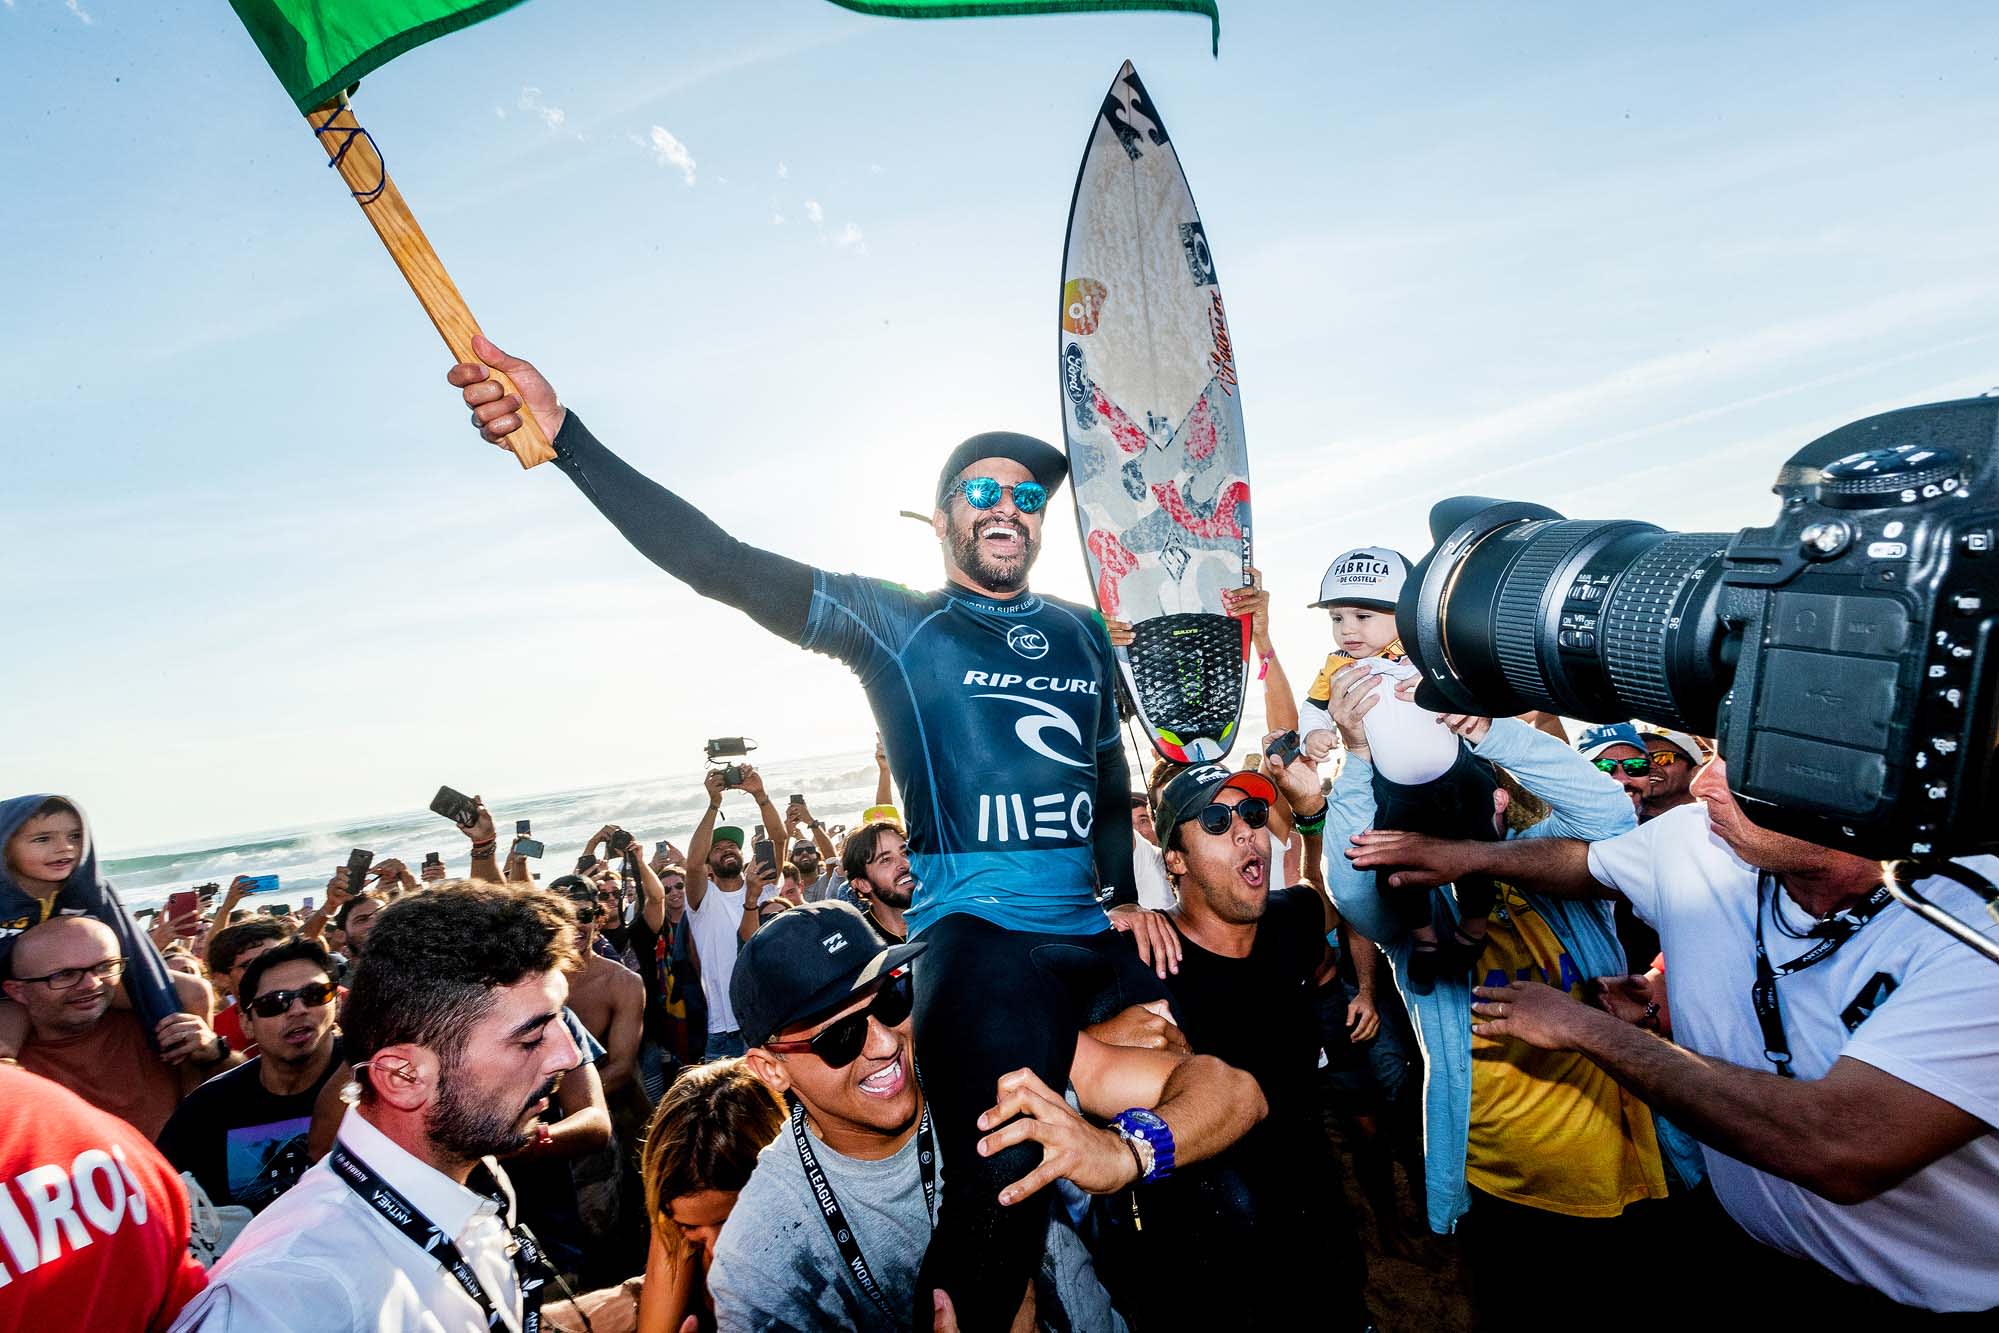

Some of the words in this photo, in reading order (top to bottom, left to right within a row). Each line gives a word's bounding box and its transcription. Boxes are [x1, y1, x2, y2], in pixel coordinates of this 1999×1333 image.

[1067, 355, 1082, 393] Ford
[1335, 562, 1389, 576] FÁBRICA
[1349, 575, 1377, 583] COSTELA
[1691, 569, 1705, 580] 28
[1574, 614, 1585, 623] VR
[1669, 617, 1680, 630] 35
[963, 670, 1023, 688] RIP
[1026, 676, 1099, 695] CURL
[1802, 938, 1836, 962] ANTHEA
[797, 1137, 816, 1168] SURF
[809, 1168, 837, 1216] LEAGUE
[372, 1189, 413, 1226] ANTHEA
[453, 1261, 481, 1298] ANTHEA
[851, 1256, 881, 1300] WORLD
